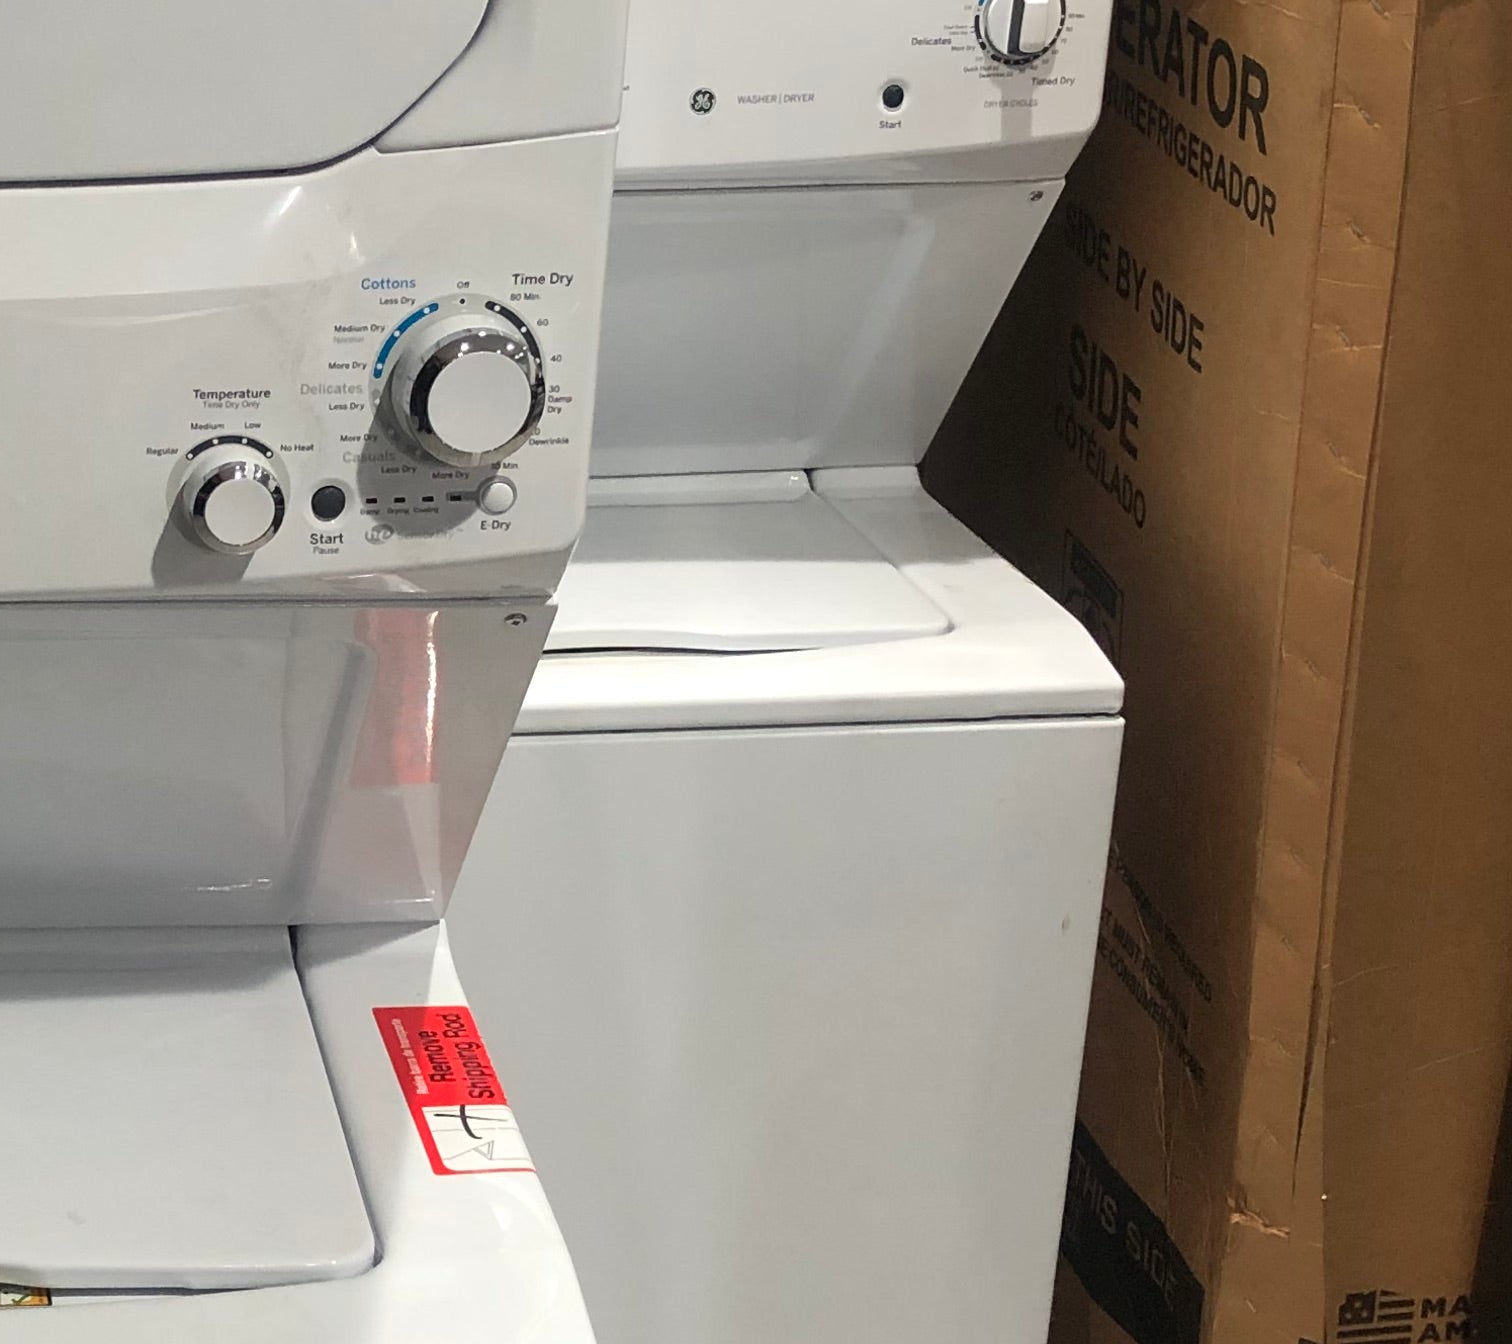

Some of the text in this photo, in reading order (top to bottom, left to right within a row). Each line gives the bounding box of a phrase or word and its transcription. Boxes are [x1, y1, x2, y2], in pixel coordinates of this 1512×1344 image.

[912, 36, 952, 46] Delicates
[1031, 76, 1075, 87] Timed Dry
[737, 93, 815, 104] WASHER DRYER
[879, 120, 902, 129] Start
[361, 277, 416, 290] Cottons
[456, 280, 470, 289] Off
[512, 272, 574, 287] Time Dry
[379, 297, 416, 307] Less Dry
[1116, 246, 1146, 312] BY
[1151, 279, 1204, 374] SIDE
[537, 318, 549, 327] 60
[334, 323, 386, 334] Medium Dry
[549, 355, 563, 363] 40
[328, 360, 367, 371] More Dry
[300, 383, 363, 395] Delicates
[548, 385, 561, 394] 30
[1069, 321, 1142, 461] SIDE
[193, 389, 271, 401] Temperature
[224, 400, 261, 410] Dry Only
[328, 402, 365, 412] Less Dry
[547, 405, 562, 416] Dry
[190, 422, 225, 431] Medium
[244, 421, 262, 430] Low
[340, 434, 378, 443] More Dry
[146, 447, 179, 456] Regular
[280, 444, 315, 452] No Heat
[343, 451, 396, 464] Casuals
[402, 465, 418, 475] Dry
[454, 470, 471, 481] Dry
[309, 533, 344, 546] Start
[419, 1030, 457, 1083] Remove
[436, 1013, 496, 1099] Shipping Rod
